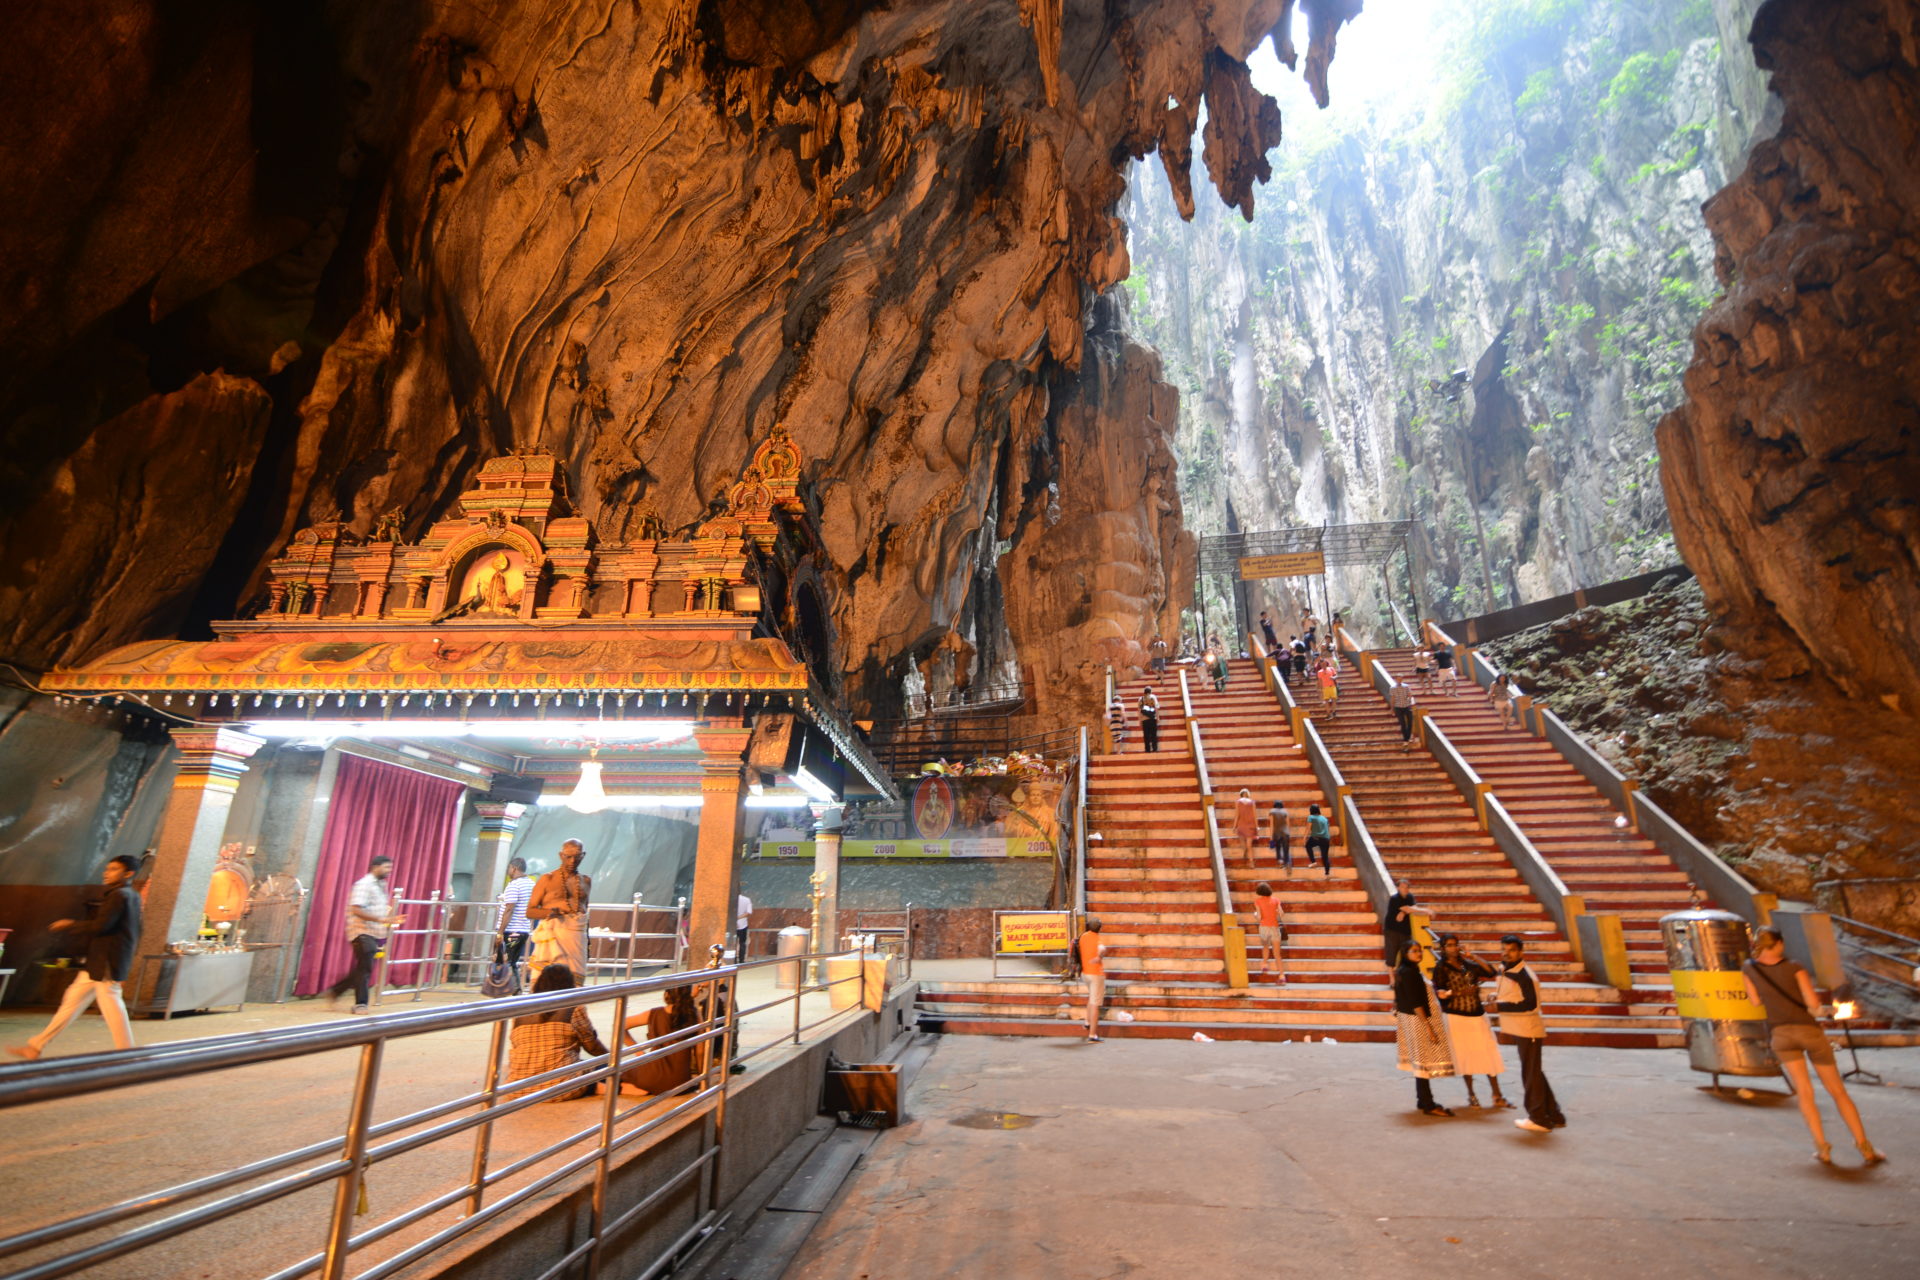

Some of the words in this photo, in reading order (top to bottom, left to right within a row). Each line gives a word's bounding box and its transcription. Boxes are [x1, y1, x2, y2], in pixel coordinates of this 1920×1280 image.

[779, 846, 798, 855] 1950
[874, 845, 896, 854] 2000
[1007, 933, 1029, 942] MAIN
[1031, 932, 1067, 941] TEMPLE
